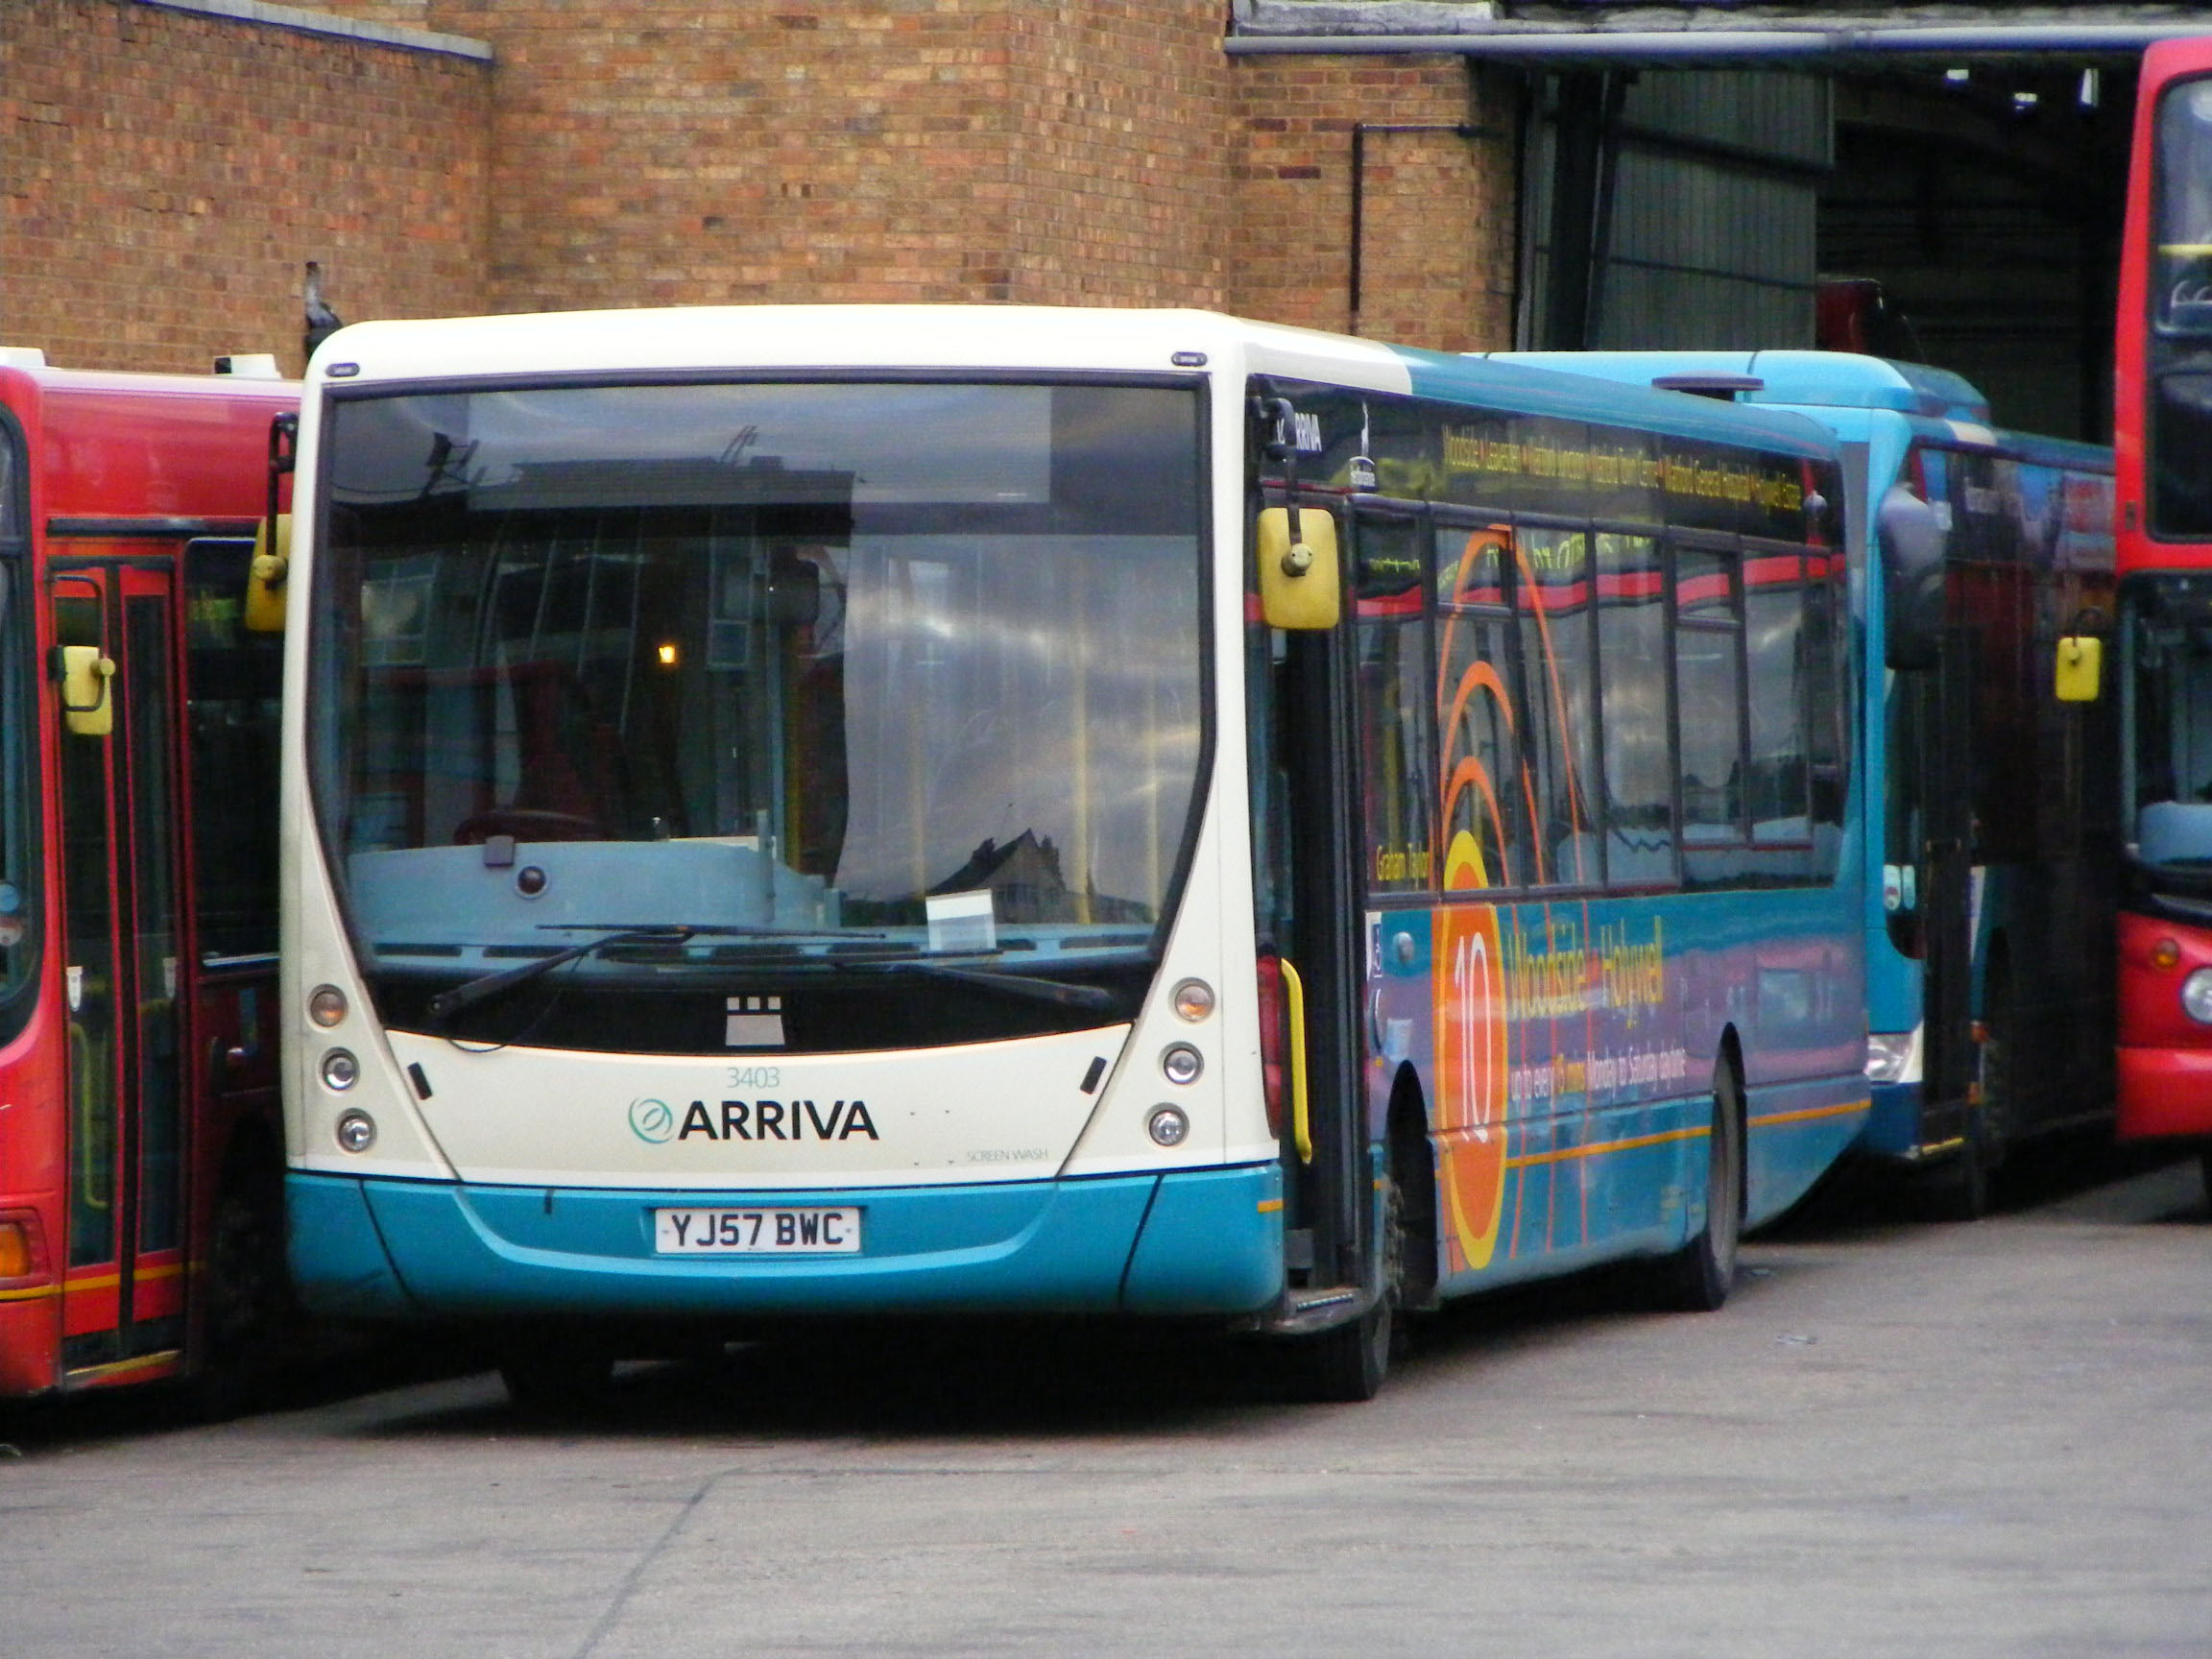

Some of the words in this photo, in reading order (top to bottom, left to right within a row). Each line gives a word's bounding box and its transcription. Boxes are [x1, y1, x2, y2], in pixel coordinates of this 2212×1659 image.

[1291, 412, 1322, 452] RRIVA
[1455, 931, 1491, 1142] 10
[727, 1066, 781, 1089] 3403
[678, 1099, 879, 1141] ARRIVA
[967, 1149, 1010, 1162] SCREEN
[1012, 1147, 1048, 1161] WASH
[672, 1214, 763, 1246] YJ57
[776, 1213, 843, 1246] BWC
